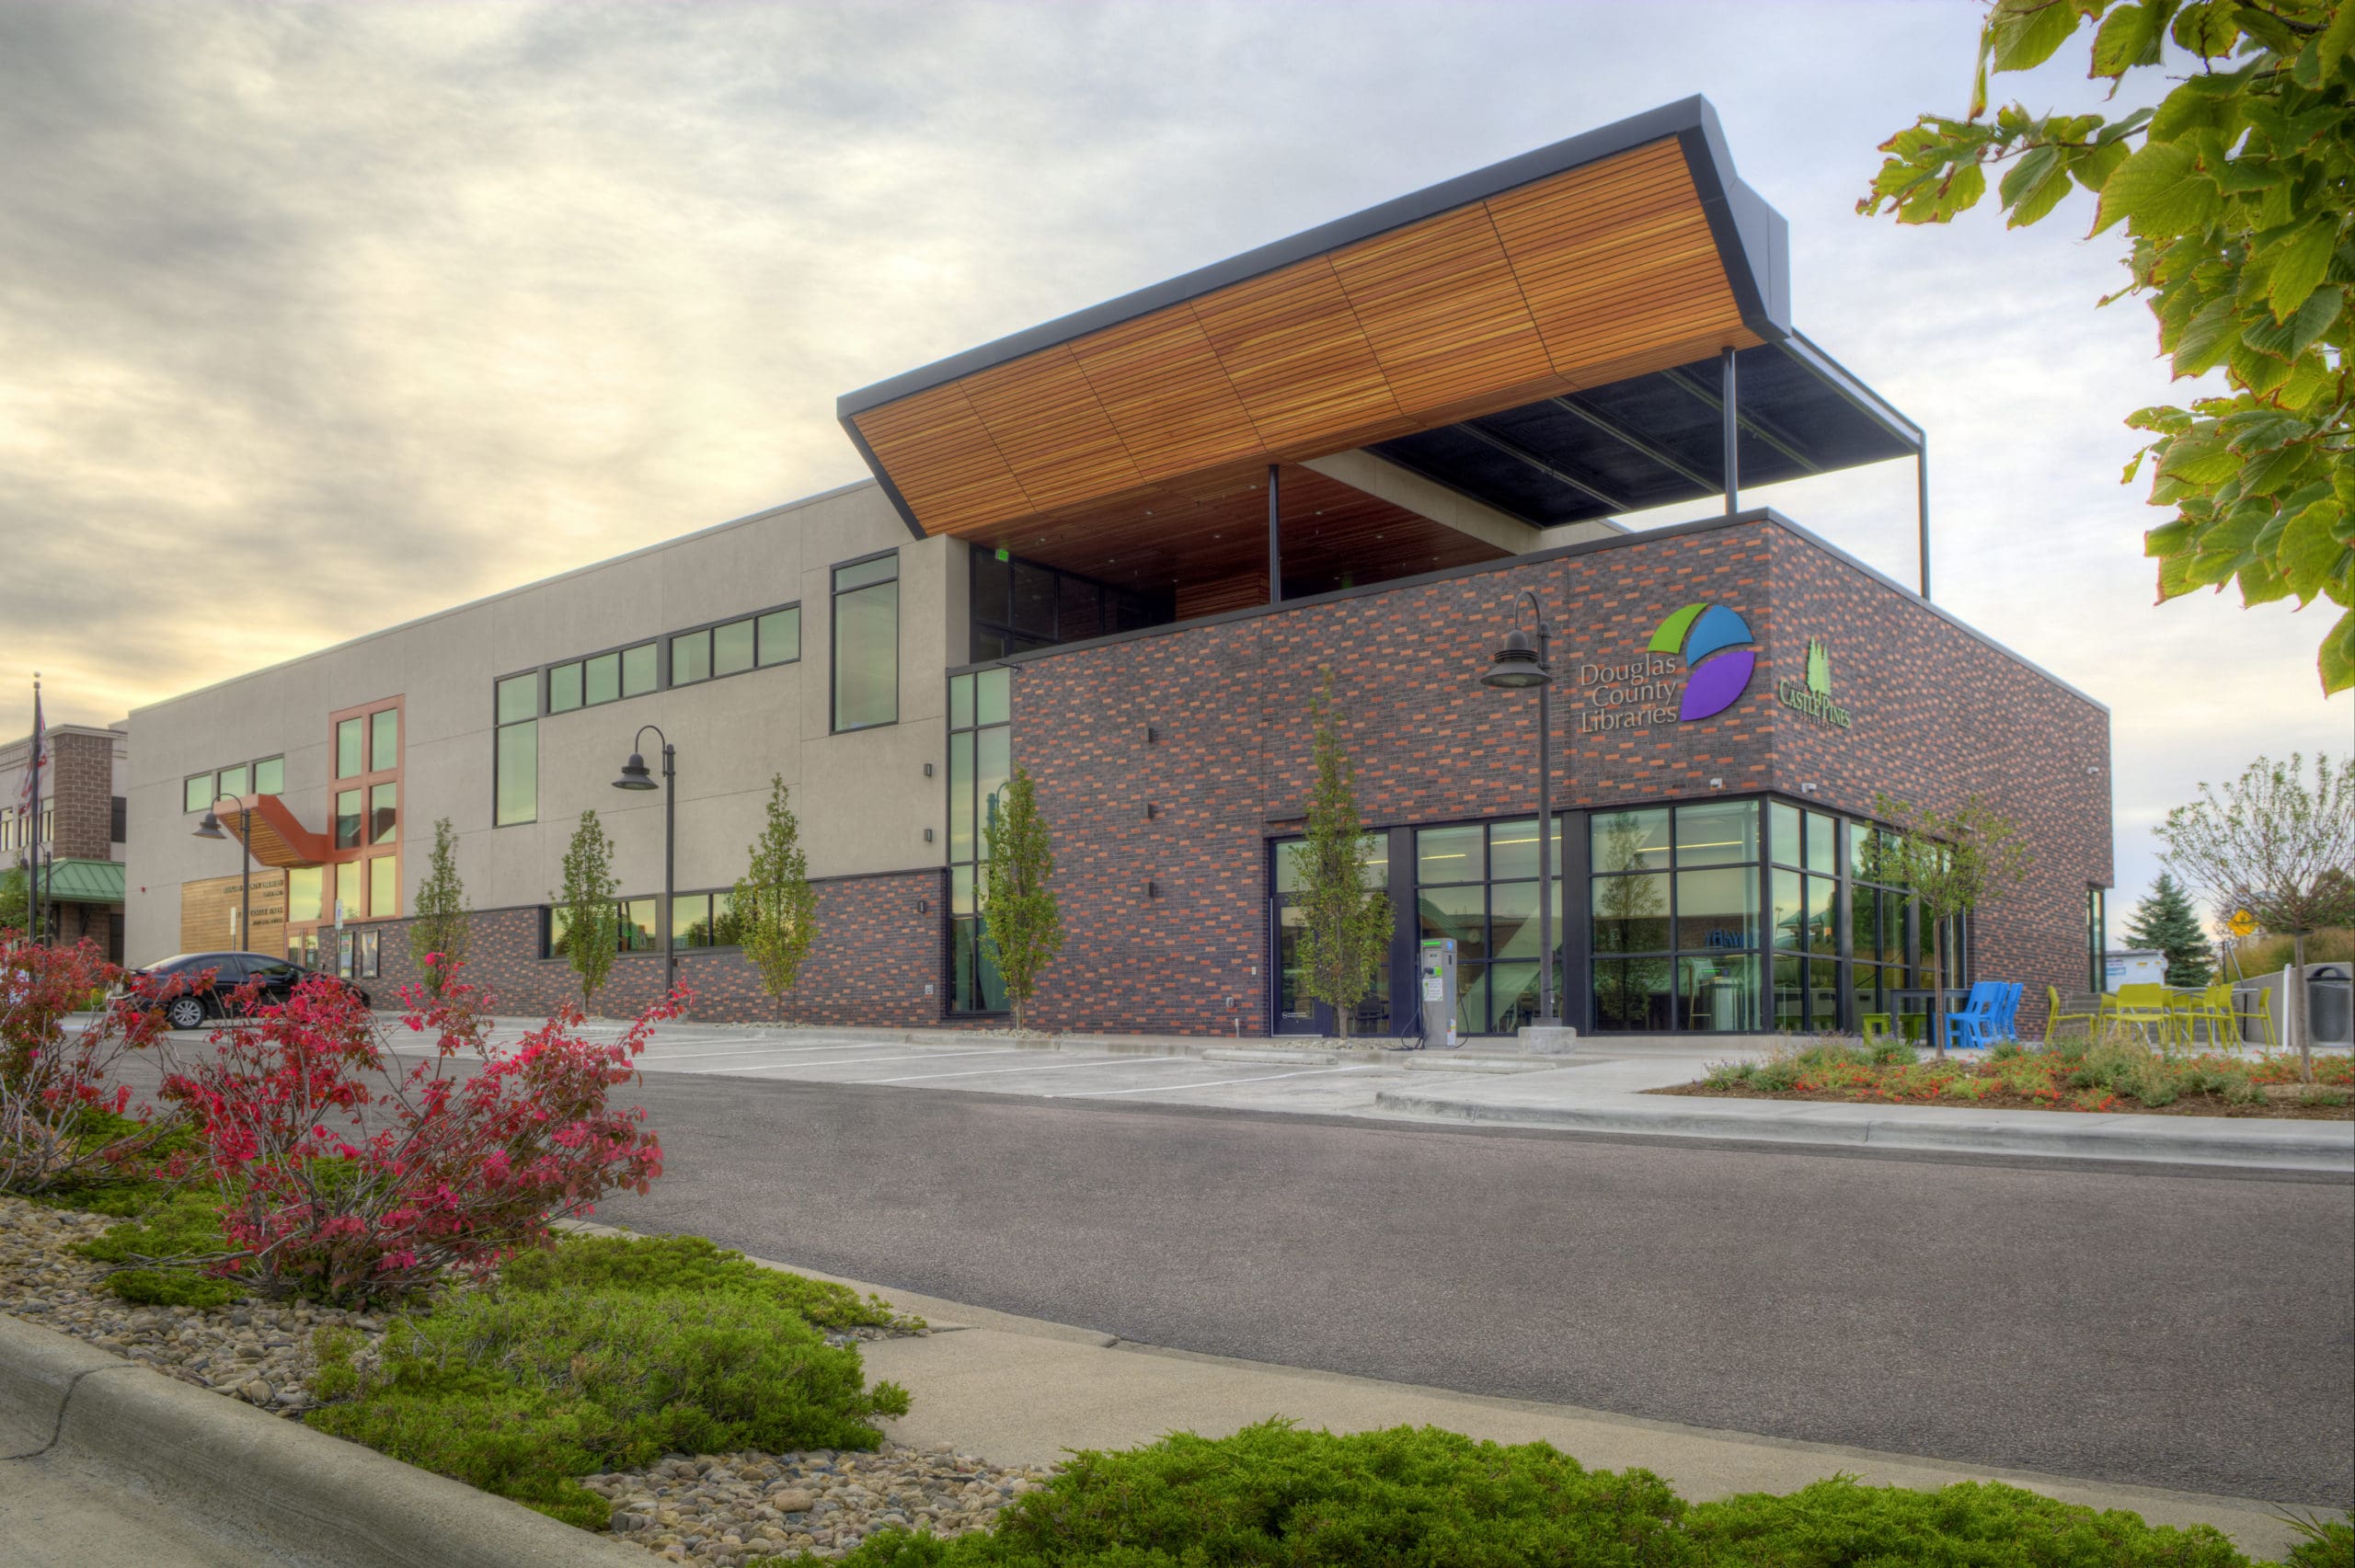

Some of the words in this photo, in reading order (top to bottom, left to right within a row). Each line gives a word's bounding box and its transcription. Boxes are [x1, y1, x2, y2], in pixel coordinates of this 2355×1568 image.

[1580, 653, 1676, 686] Douglas
[1592, 680, 1676, 707] County
[1582, 704, 1677, 733] Libraries
